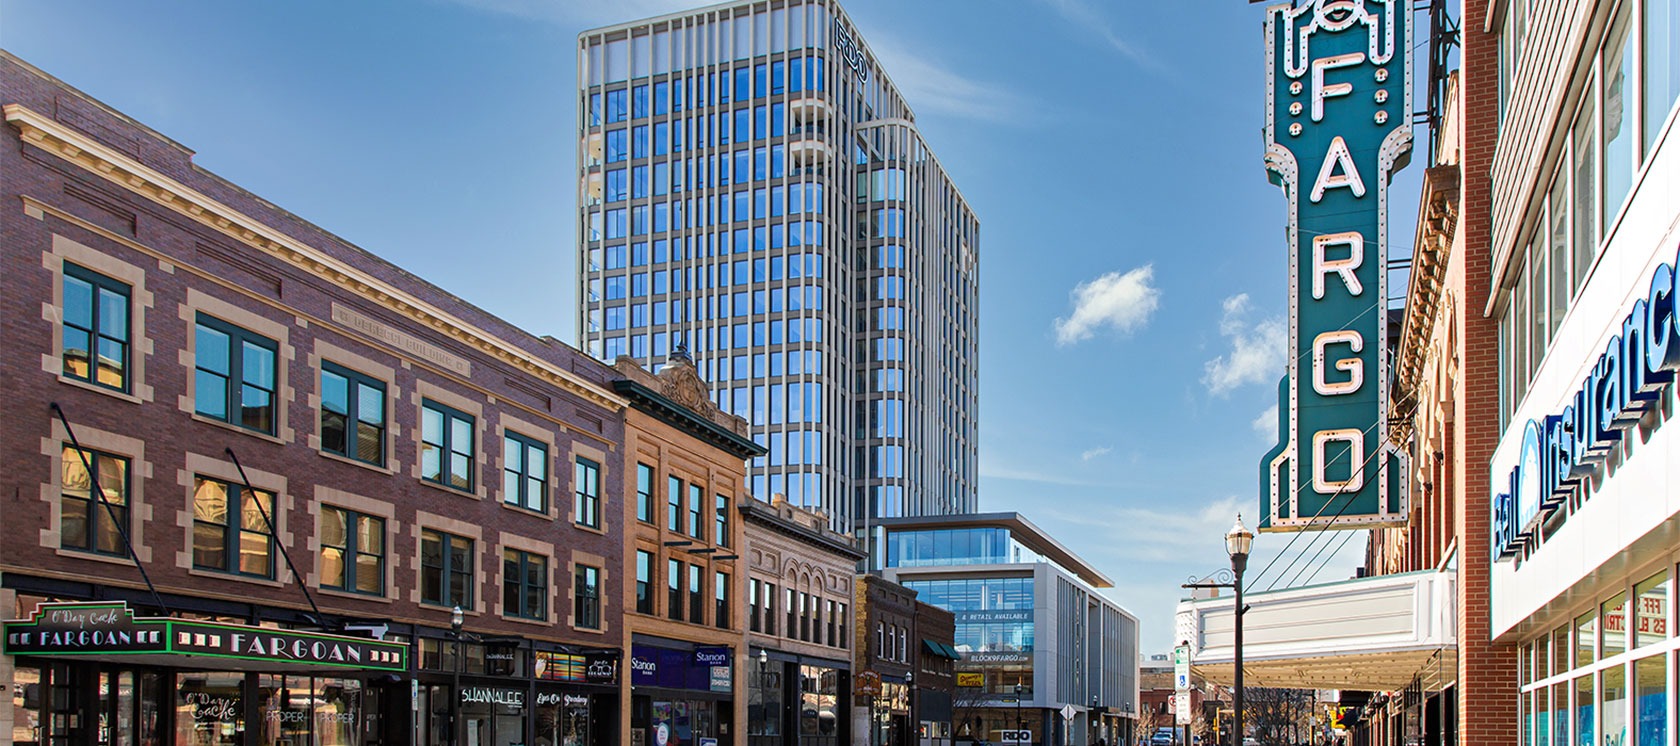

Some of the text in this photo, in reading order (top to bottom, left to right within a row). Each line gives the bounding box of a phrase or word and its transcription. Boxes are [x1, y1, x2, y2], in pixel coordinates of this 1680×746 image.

[835, 17, 868, 84] RDO
[1310, 52, 1367, 495] FARGO
[40, 630, 131, 647] FARGOAN
[230, 633, 361, 663] FARGOAN
[461, 687, 522, 705] SHANNALEE
[1003, 731, 1030, 741] RDO
